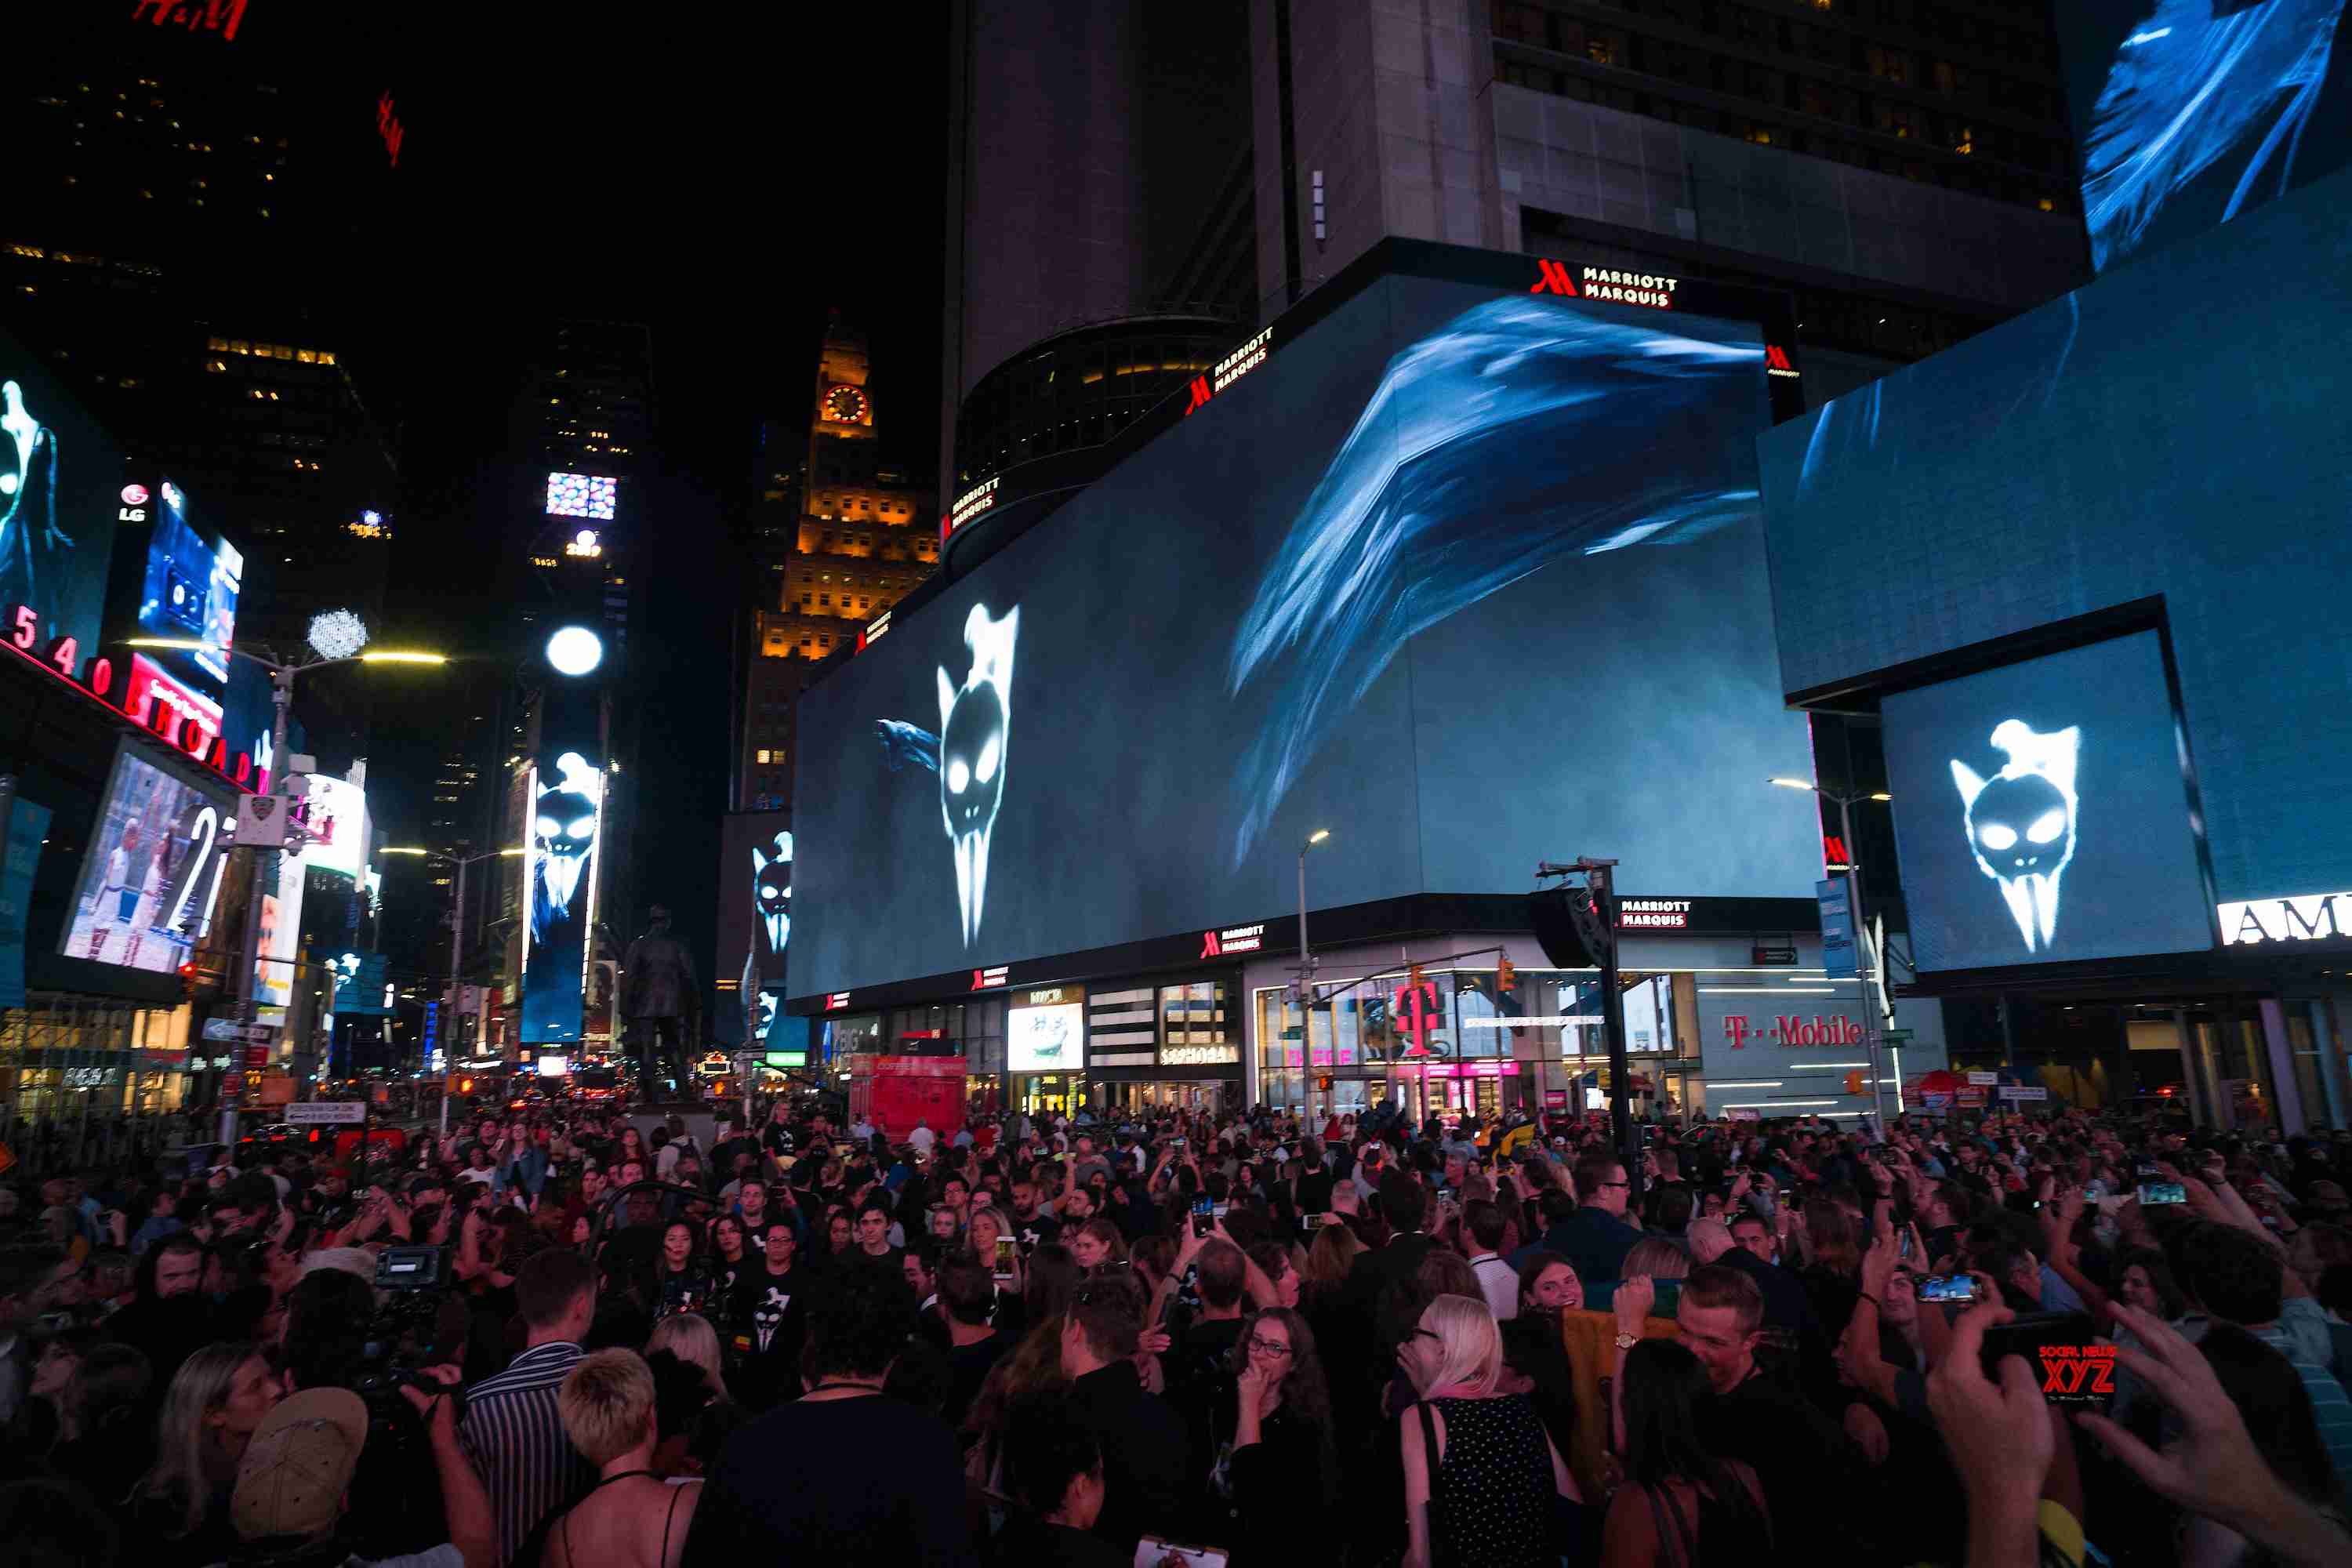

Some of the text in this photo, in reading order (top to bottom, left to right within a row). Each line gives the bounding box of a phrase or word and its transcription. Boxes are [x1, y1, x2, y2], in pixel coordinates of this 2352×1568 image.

[1583, 267, 1679, 292] MARRIOTT
[1584, 283, 1669, 308] MARQUIS
[1214, 327, 1273, 377] MARRIOTT
[1214, 347, 1267, 393] MARQUIS
[952, 477, 1000, 515] MARRIOTT
[118, 507, 146, 522] LG
[952, 495, 994, 529] MARQUIS
[1621, 901, 1691, 912] MARRIOTT
[1622, 914, 1685, 926] MARQUIS
[2232, 893, 2352, 948] AM
